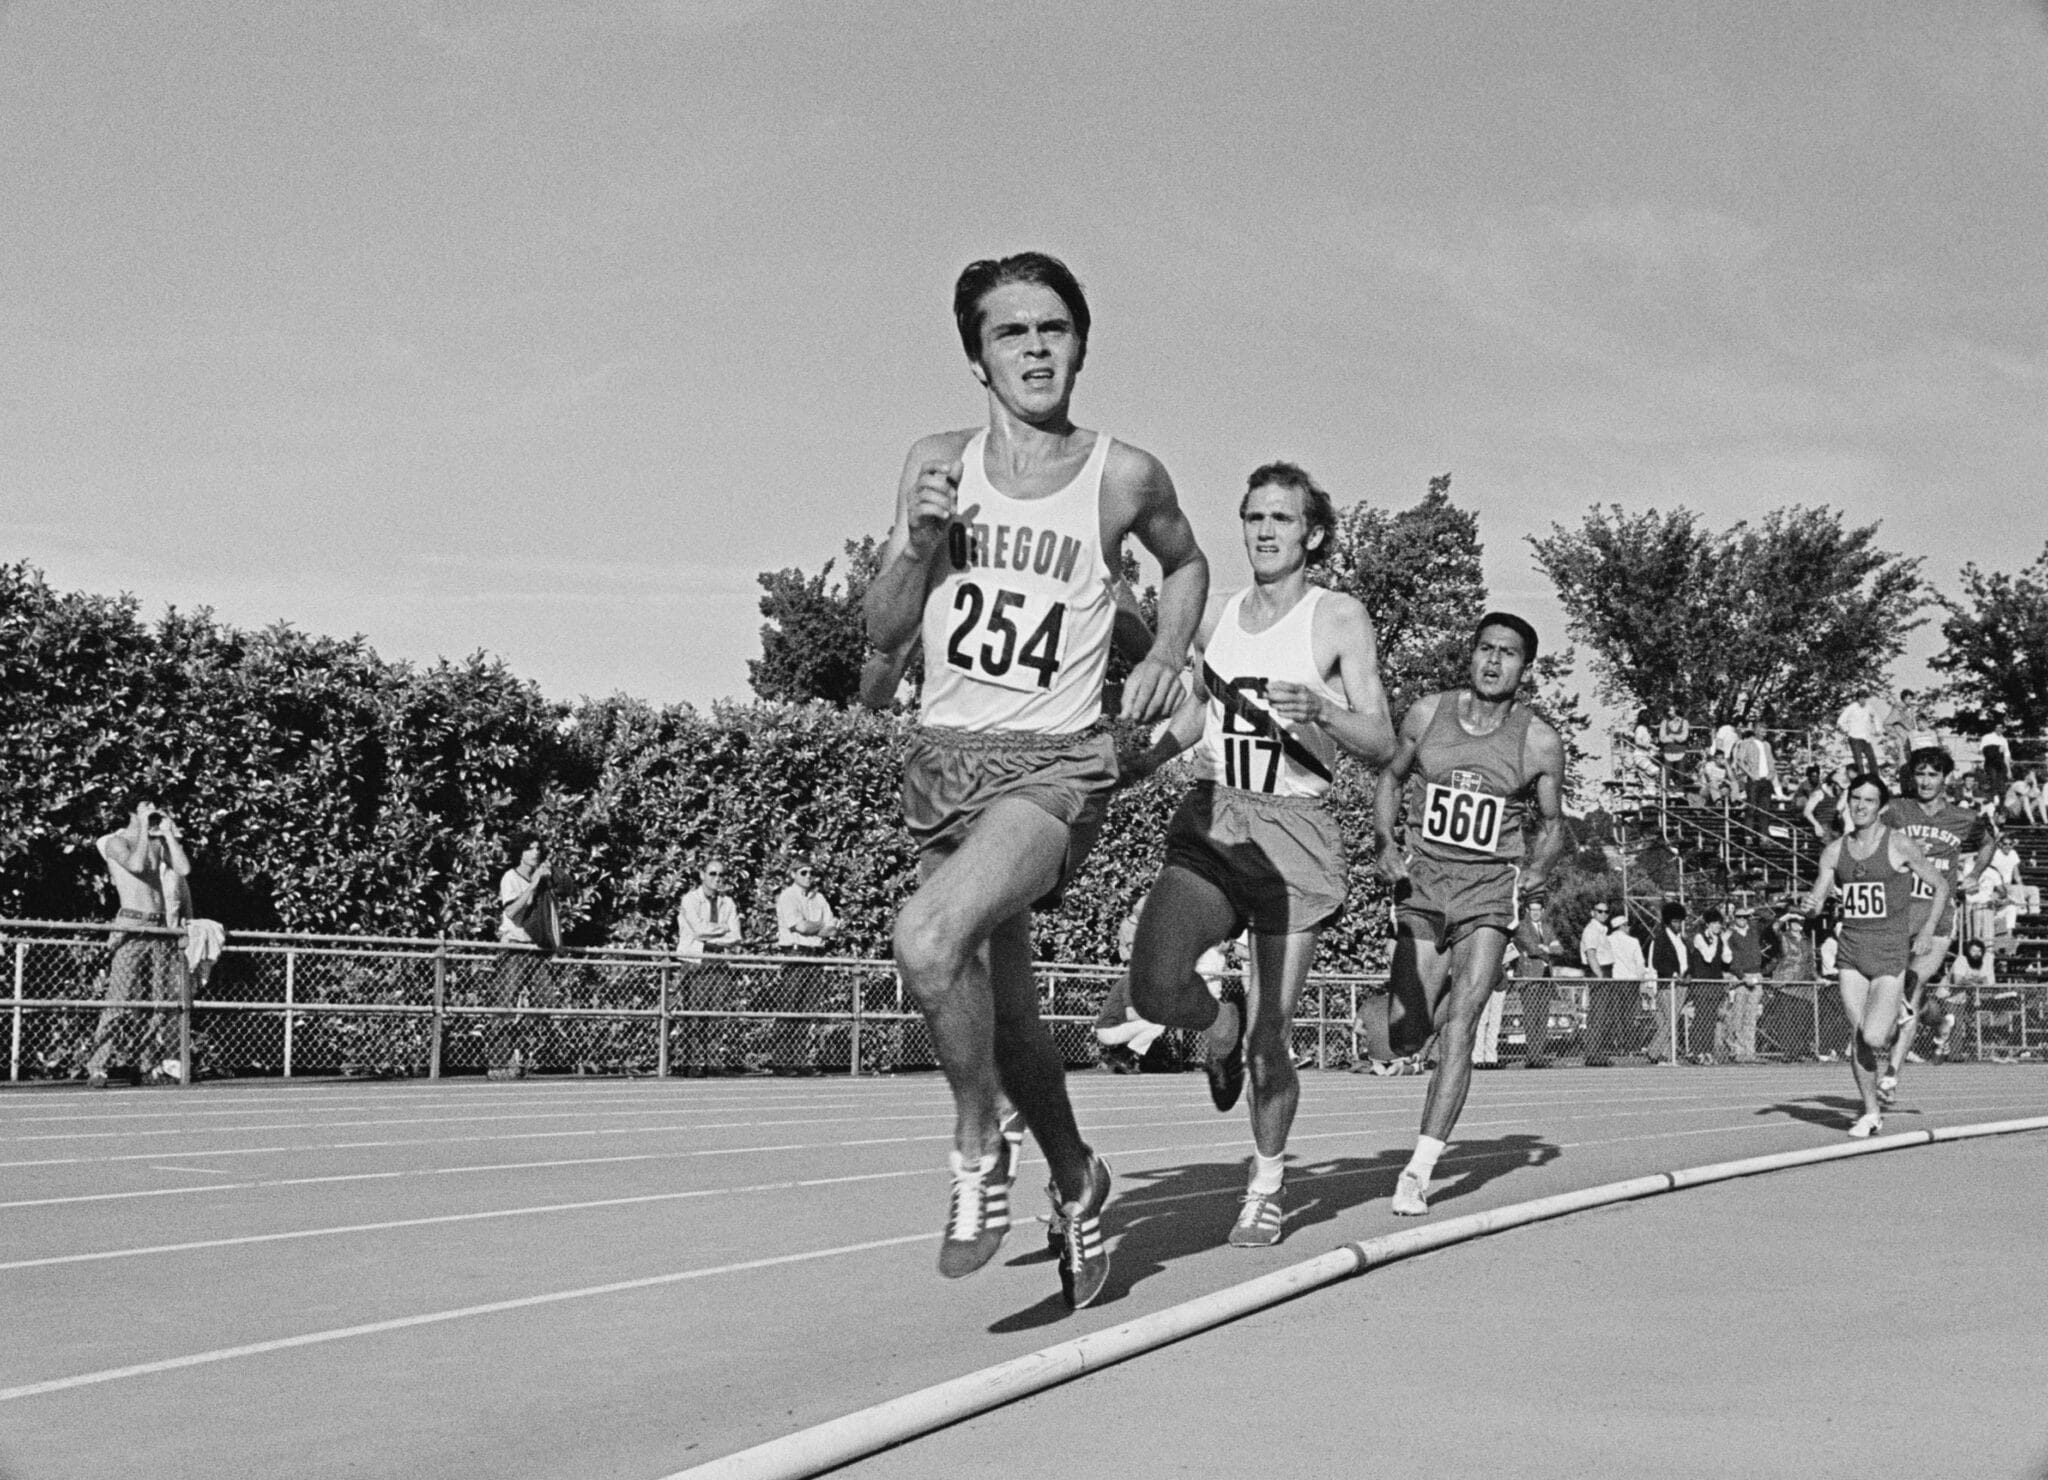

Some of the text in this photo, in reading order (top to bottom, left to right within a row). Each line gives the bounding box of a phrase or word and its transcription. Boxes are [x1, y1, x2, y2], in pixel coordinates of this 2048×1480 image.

[950, 522, 1082, 582] OREGON
[948, 582, 1066, 688] 254
[1224, 738, 1282, 793] 117
[1428, 788, 1497, 847] 560
[1844, 885, 1884, 916] 456
